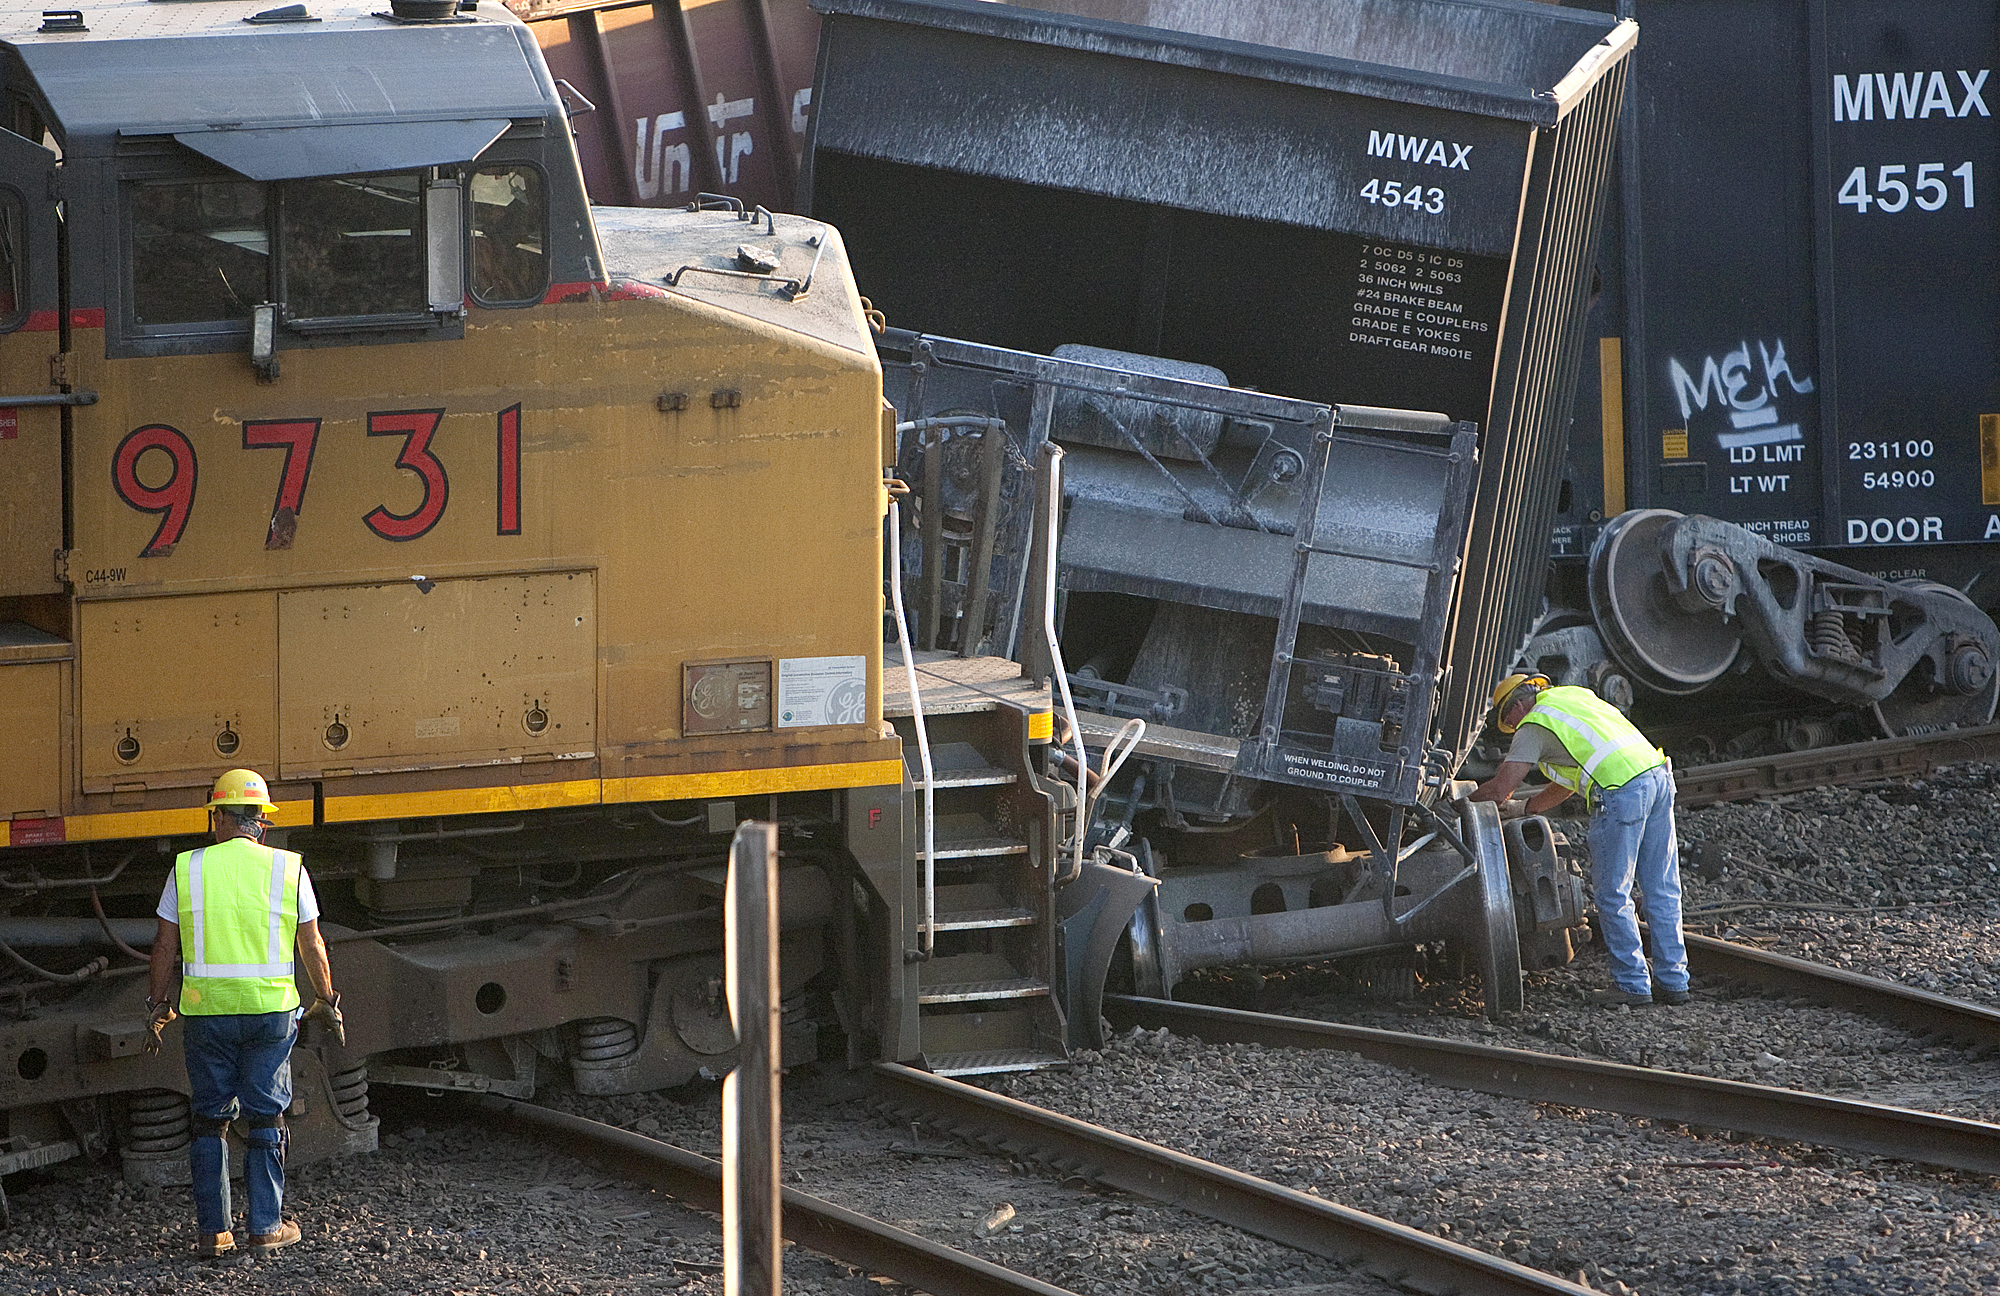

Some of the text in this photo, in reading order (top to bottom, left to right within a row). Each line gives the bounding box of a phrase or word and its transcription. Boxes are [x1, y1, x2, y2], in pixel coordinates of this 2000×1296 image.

[1833, 69, 1992, 122] MWAX
[1367, 130, 1474, 171] MWAX
[1360, 178, 1445, 215] 4543
[1838, 161, 1976, 214] 4551
[1362, 244, 1369, 254] 7
[1397, 250, 1413, 261] D5
[1417, 253, 1425, 262] 5
[1429, 255, 1442, 265] IC
[1447, 258, 1464, 269] D5
[1360, 259, 1462, 283] 2 5062 2 5063
[1358, 273, 1444, 295] 36 INCH WHLS
[1357, 288, 1463, 313] #24 BRAKE BEAM
[1353, 302, 1489, 332] GRADE E COUPLERS
[1351, 317, 1461, 343] GRADE E YOKES
[1350, 332, 1473, 361] DRAFT GEAR M901E
[1730, 439, 1935, 463] LD LMT 231100
[111, 401, 523, 559] 9731
[1730, 470, 1936, 493] LT WT 54900
[1743, 521, 1771, 532] INCH
[1773, 520, 1810, 531] TREAD
[1772, 532, 1811, 543] SHOES
[1847, 516, 1944, 544] DOOR
[1551, 536, 1573, 544] HERE
[86, 567, 127, 584] C44-9W
[1889, 568, 1927, 579] CLEAR
[1284, 754, 1386, 778] WHEN WELDING, DO NOT
[1287, 767, 1379, 788] GROUND TO COUPLER
[868, 808, 881, 829] F
